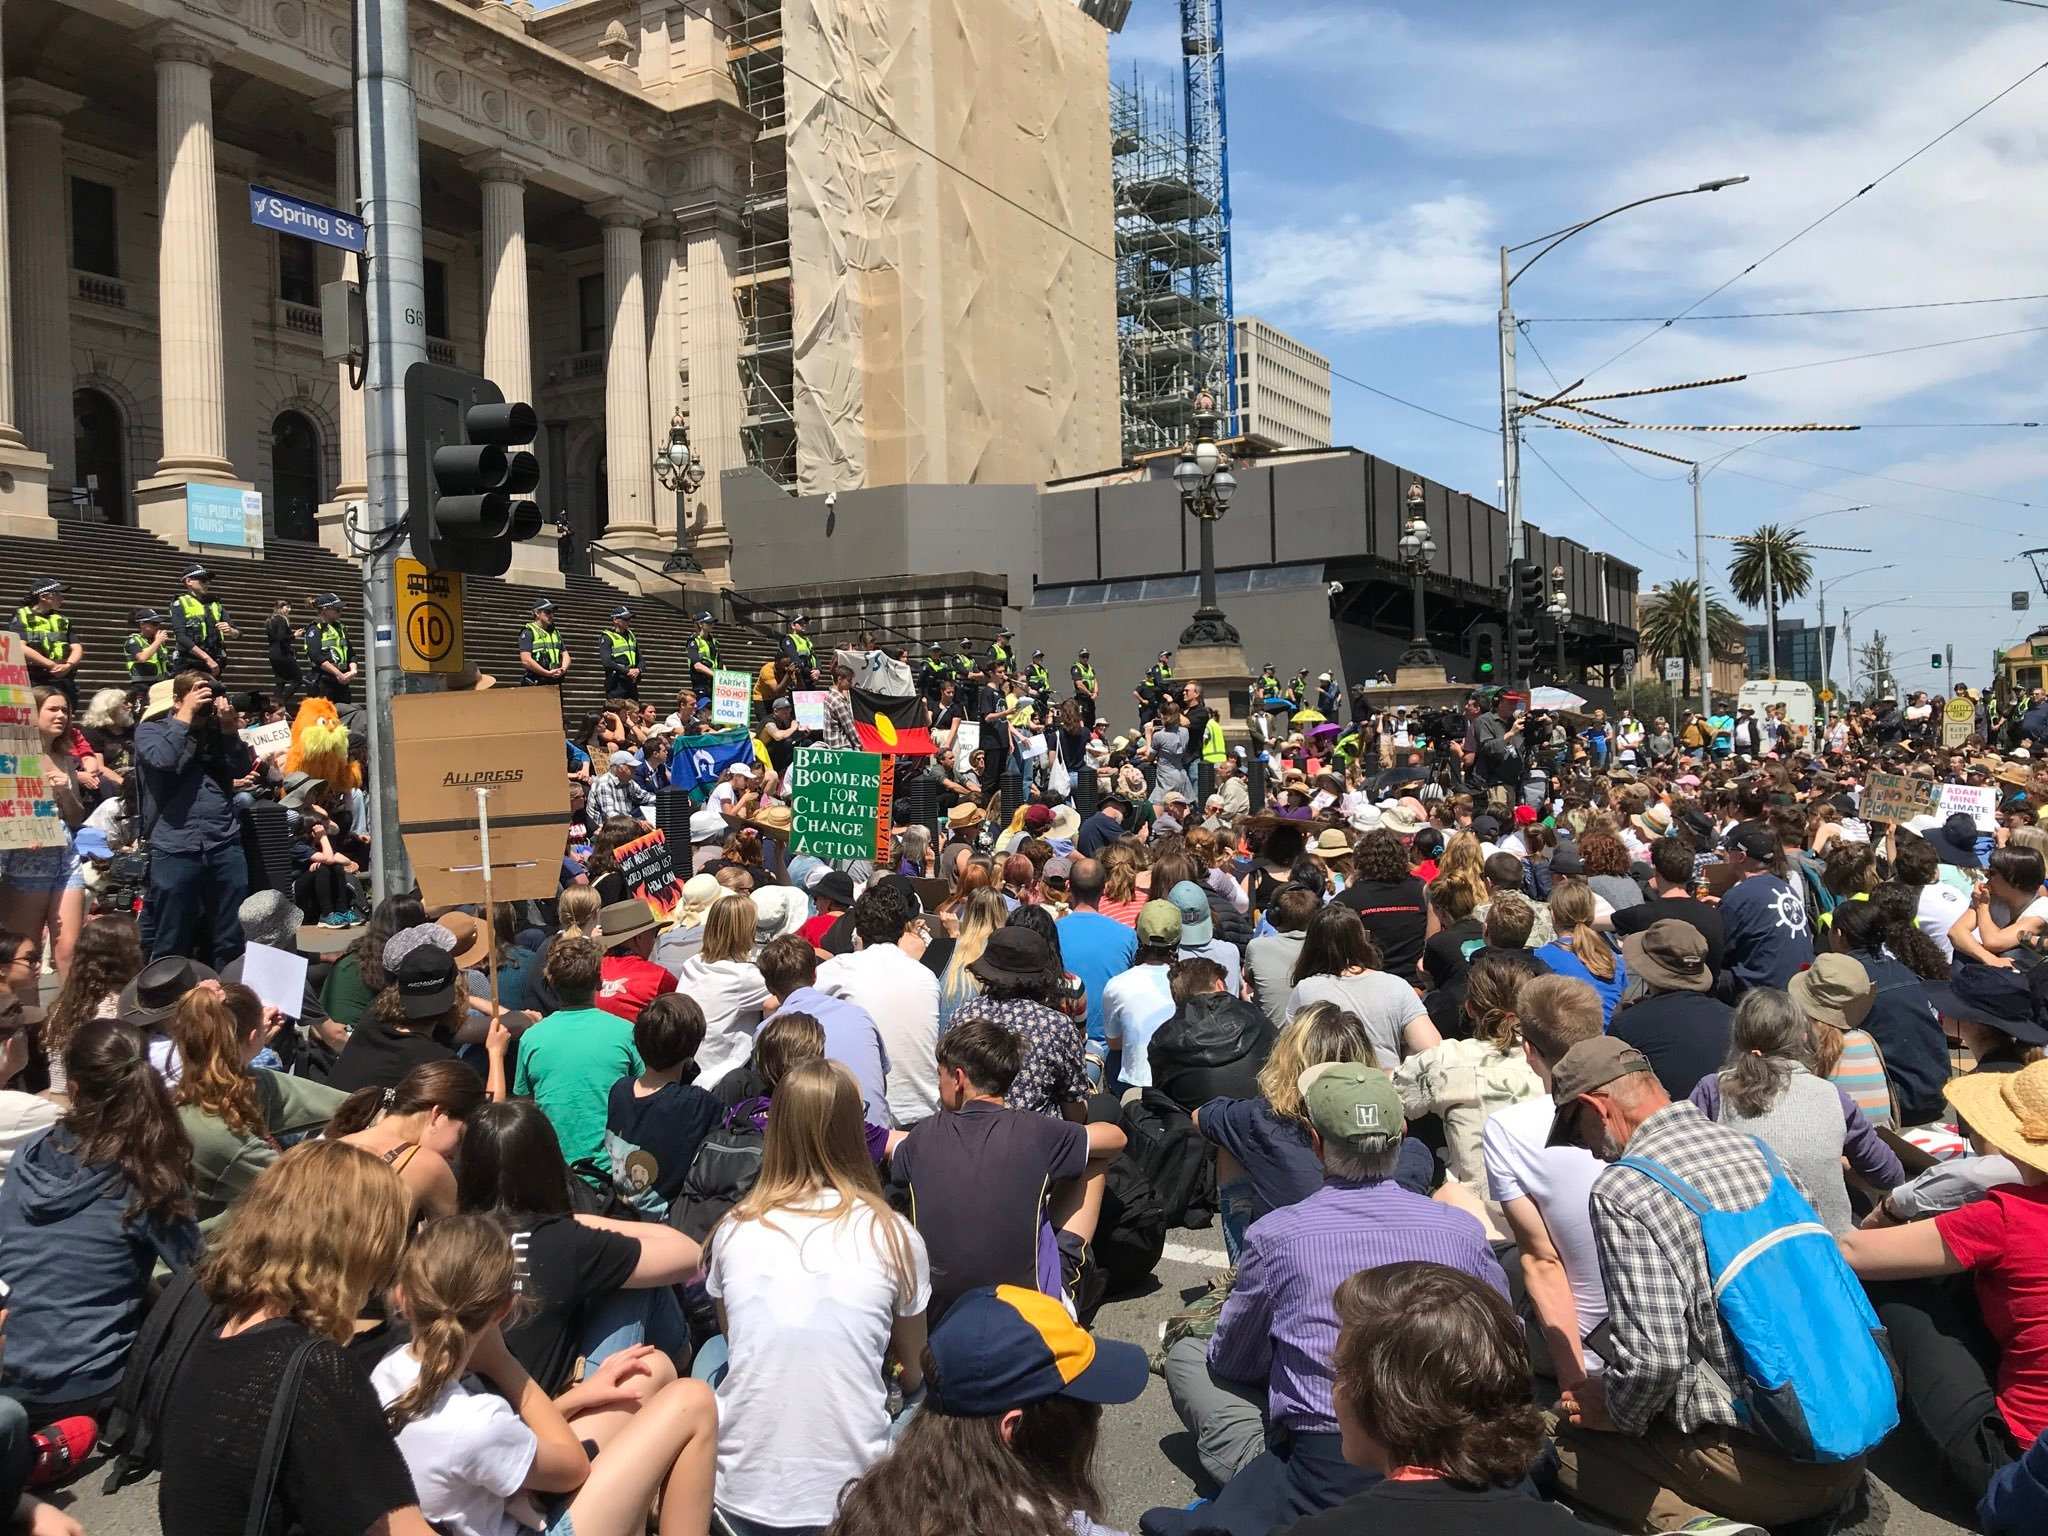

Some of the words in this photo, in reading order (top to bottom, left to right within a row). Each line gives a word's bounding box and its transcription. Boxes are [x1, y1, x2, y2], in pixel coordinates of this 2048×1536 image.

[270, 199, 329, 236] Spring
[335, 218, 355, 240] St
[405, 308, 424, 327] 66
[192, 516, 224, 533] TOURS
[417, 616, 444, 647] 10
[719, 678, 747, 688] EARTH'S
[717, 688, 732, 698] TOO
[733, 690, 747, 698] HOT
[722, 699, 740, 708] LET'S
[1951, 703, 1969, 711] SAFETY
[717, 709, 735, 717] COOL
[253, 728, 290, 746] UNLESS
[796, 749, 843, 768] BABY
[442, 769, 524, 785] ALLPRESS
[796, 768, 880, 789] BOOMERS
[829, 788, 858, 803] FOR
[1946, 787, 1982, 796] ADANI
[1949, 796, 1978, 804] MINE
[793, 796, 878, 819] CLIMATE
[1940, 802, 1989, 813] CLIMATE
[792, 815, 864, 837] CHANGE
[634, 847, 652, 865] ABOUT
[652, 843, 666, 856] THE
[794, 834, 867, 858] ACTION
[625, 871, 642, 887] WORLD
[641, 862, 661, 878] AROUND
[661, 855, 672, 868] US?
[648, 880, 663, 893] HOW
[662, 871, 677, 885] CAN
[1360, 1107, 1374, 1124] H
